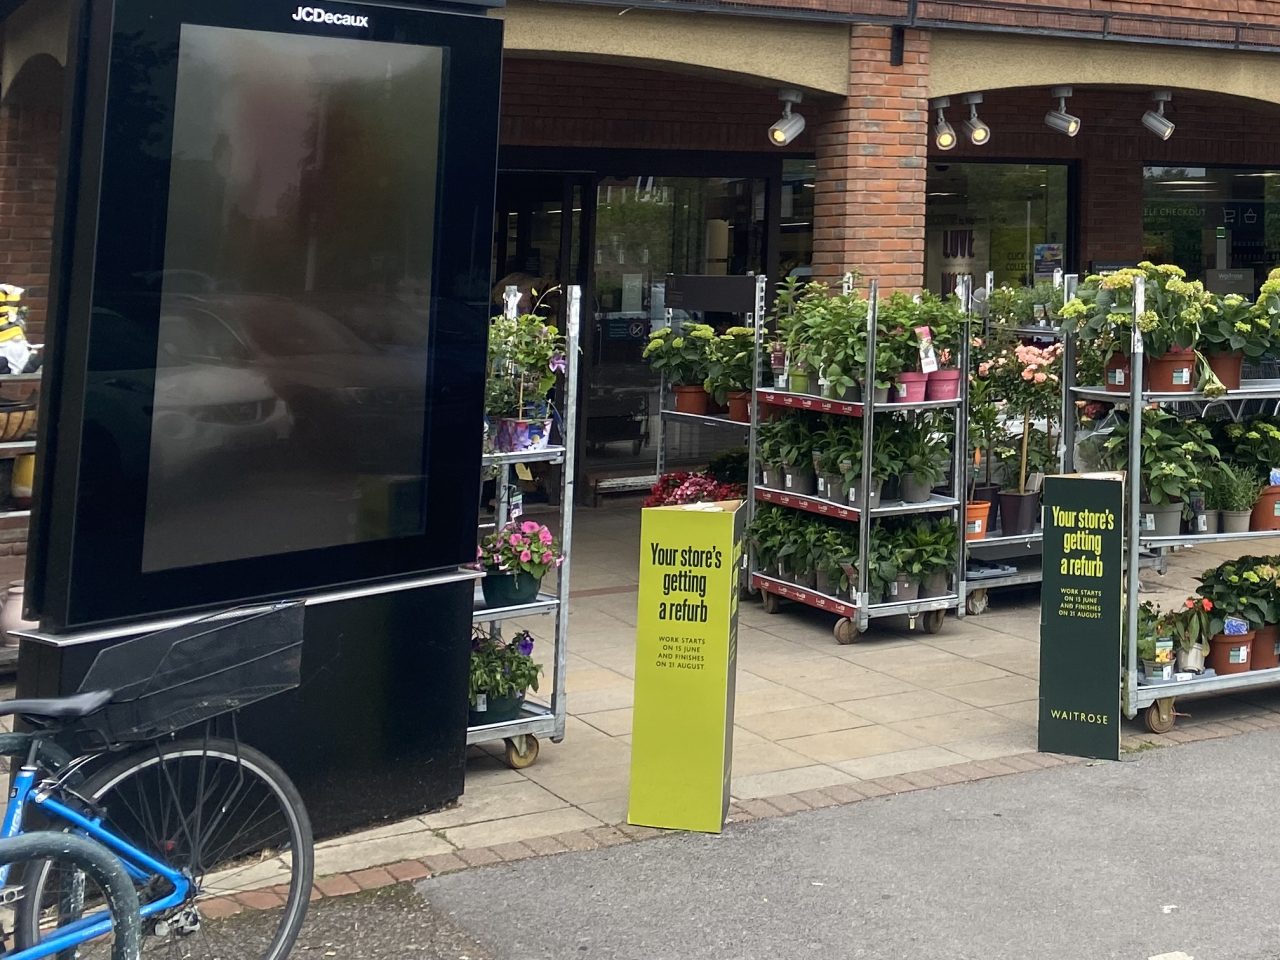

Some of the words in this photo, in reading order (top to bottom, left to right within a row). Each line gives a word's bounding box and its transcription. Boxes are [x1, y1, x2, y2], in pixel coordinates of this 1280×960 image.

[292, 6, 368, 27] JCDecaux
[1159, 208, 1206, 216] CHECKOUT
[1052, 506, 1076, 527] Your
[1078, 509, 1114, 530] store's
[1063, 530, 1102, 555] getting
[651, 542, 678, 565] Your
[680, 545, 722, 569] store's
[1060, 558, 1068, 575] a
[1069, 555, 1103, 577] refurb
[663, 570, 707, 598] getting
[1060, 587, 1079, 595] WORK
[1080, 589, 1102, 597] STARTS
[658, 602, 667, 620] a
[668, 598, 708, 623] refurb
[1075, 603, 1101, 612] FINISHES
[681, 637, 706, 645] STARTS
[675, 653, 705, 662] FINISHES
[1051, 709, 1108, 725] WAITROSE
